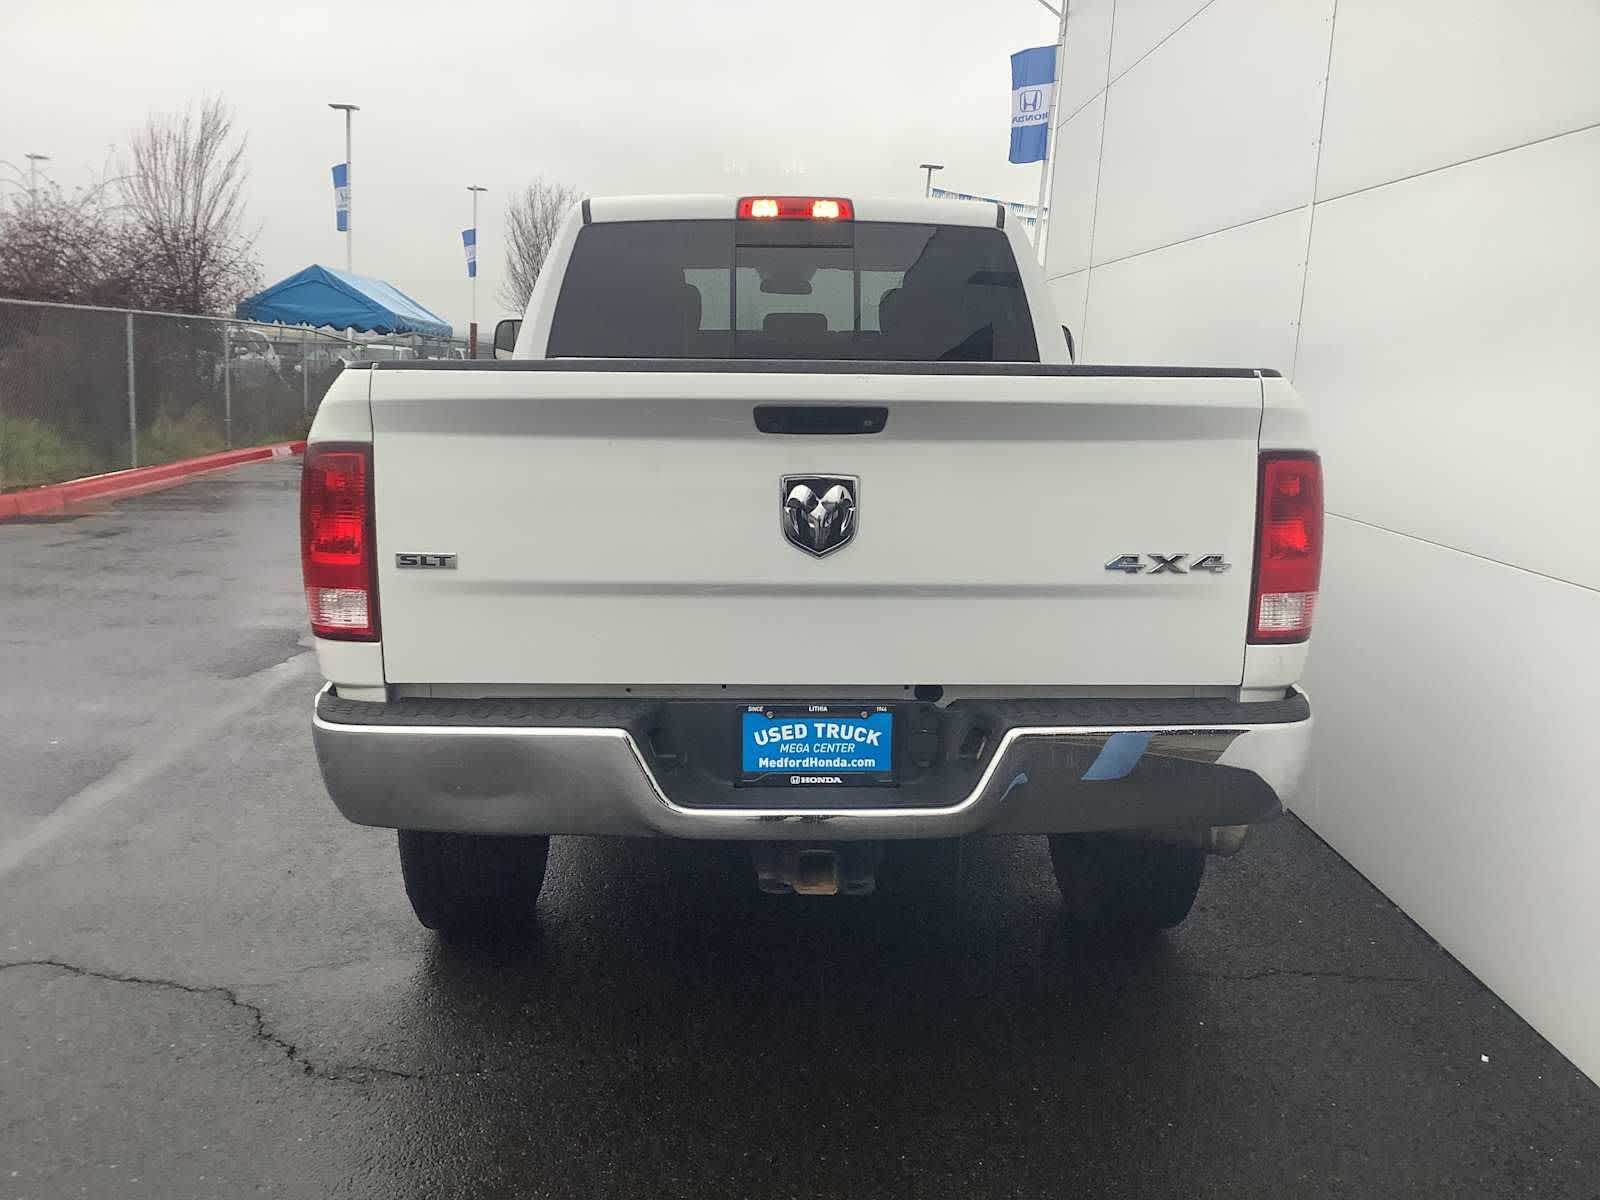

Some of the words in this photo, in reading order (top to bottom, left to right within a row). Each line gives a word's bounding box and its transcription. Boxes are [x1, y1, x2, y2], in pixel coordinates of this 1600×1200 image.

[400, 555, 452, 566] SLT
[1105, 553, 1232, 574] 4X4
[754, 724, 807, 745] USED
[813, 723, 881, 746] TRUCK
[780, 743, 810, 753] MEGA
[813, 743, 855, 753] CENTER
[758, 757, 876, 768] MedfordHonda.com
[800, 776, 842, 784] HONDA
